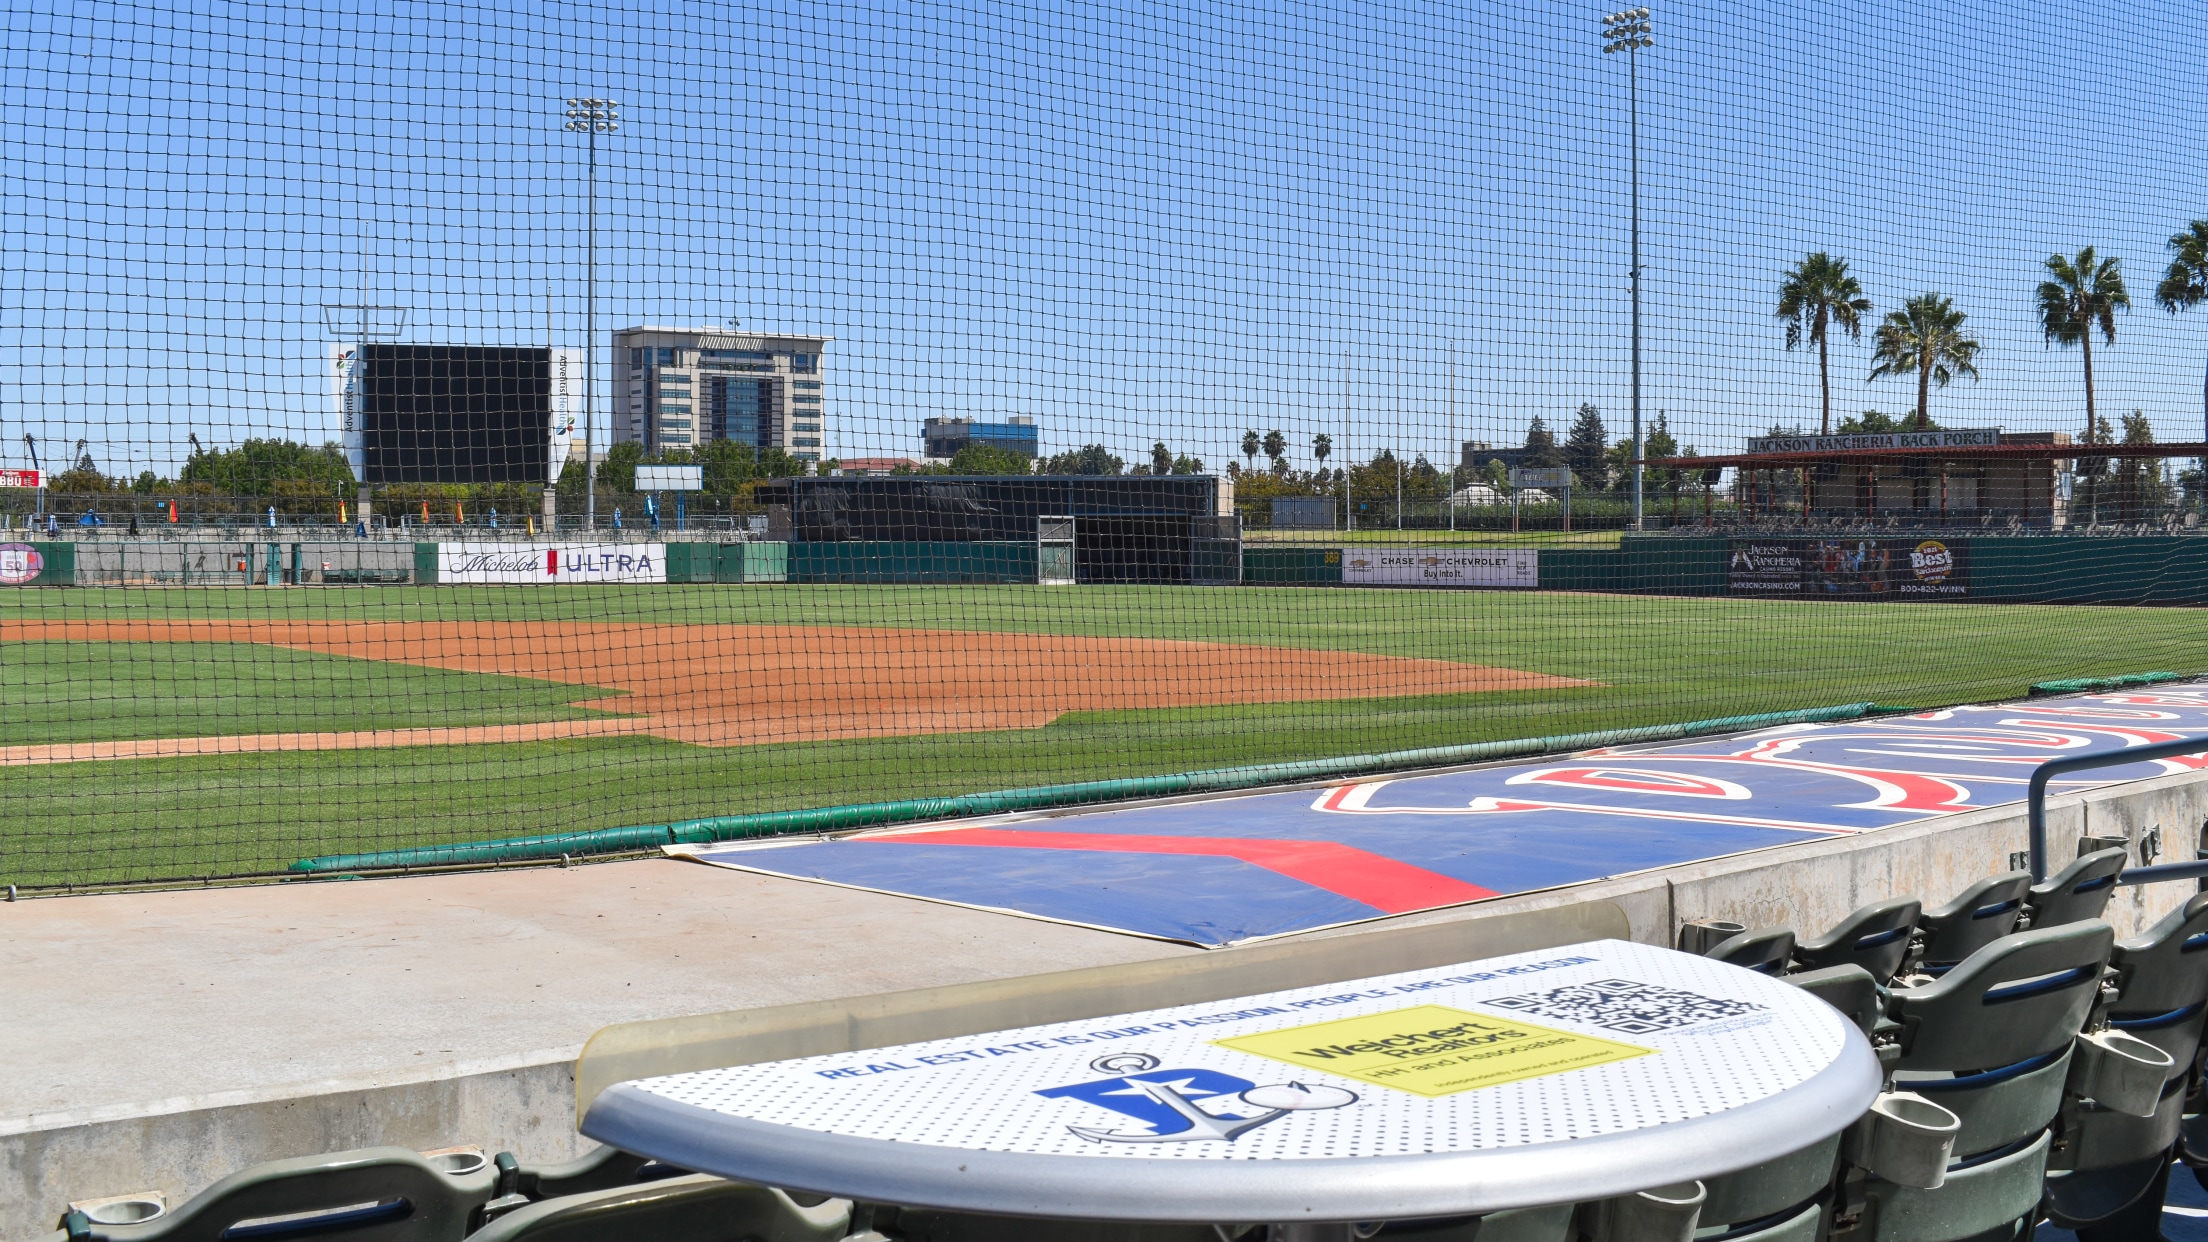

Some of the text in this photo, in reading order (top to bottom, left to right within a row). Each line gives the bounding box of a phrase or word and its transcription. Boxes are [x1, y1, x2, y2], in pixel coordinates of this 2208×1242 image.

[1751, 432, 1993, 453] JACKSON RANCHERIA BACK PORCH
[450, 553, 653, 574] Michelob ULTRA
[1381, 557, 1508, 567] CHASE CHEVROLET
[1909, 549, 1953, 568] Best
[814, 1061, 921, 1080] REAL
[915, 1040, 1051, 1066] ESTATE
[1050, 1035, 1094, 1046] IS
[1090, 1024, 1161, 1040] OUR
[1288, 988, 1399, 1011] PEOPLE
[1393, 979, 1450, 994] ARE
[1444, 971, 1503, 985] OUR
[1495, 955, 1601, 976] REASON
[1379, 1028, 1529, 1059] Realtors
[1363, 1035, 1577, 1079] HH and Associates
